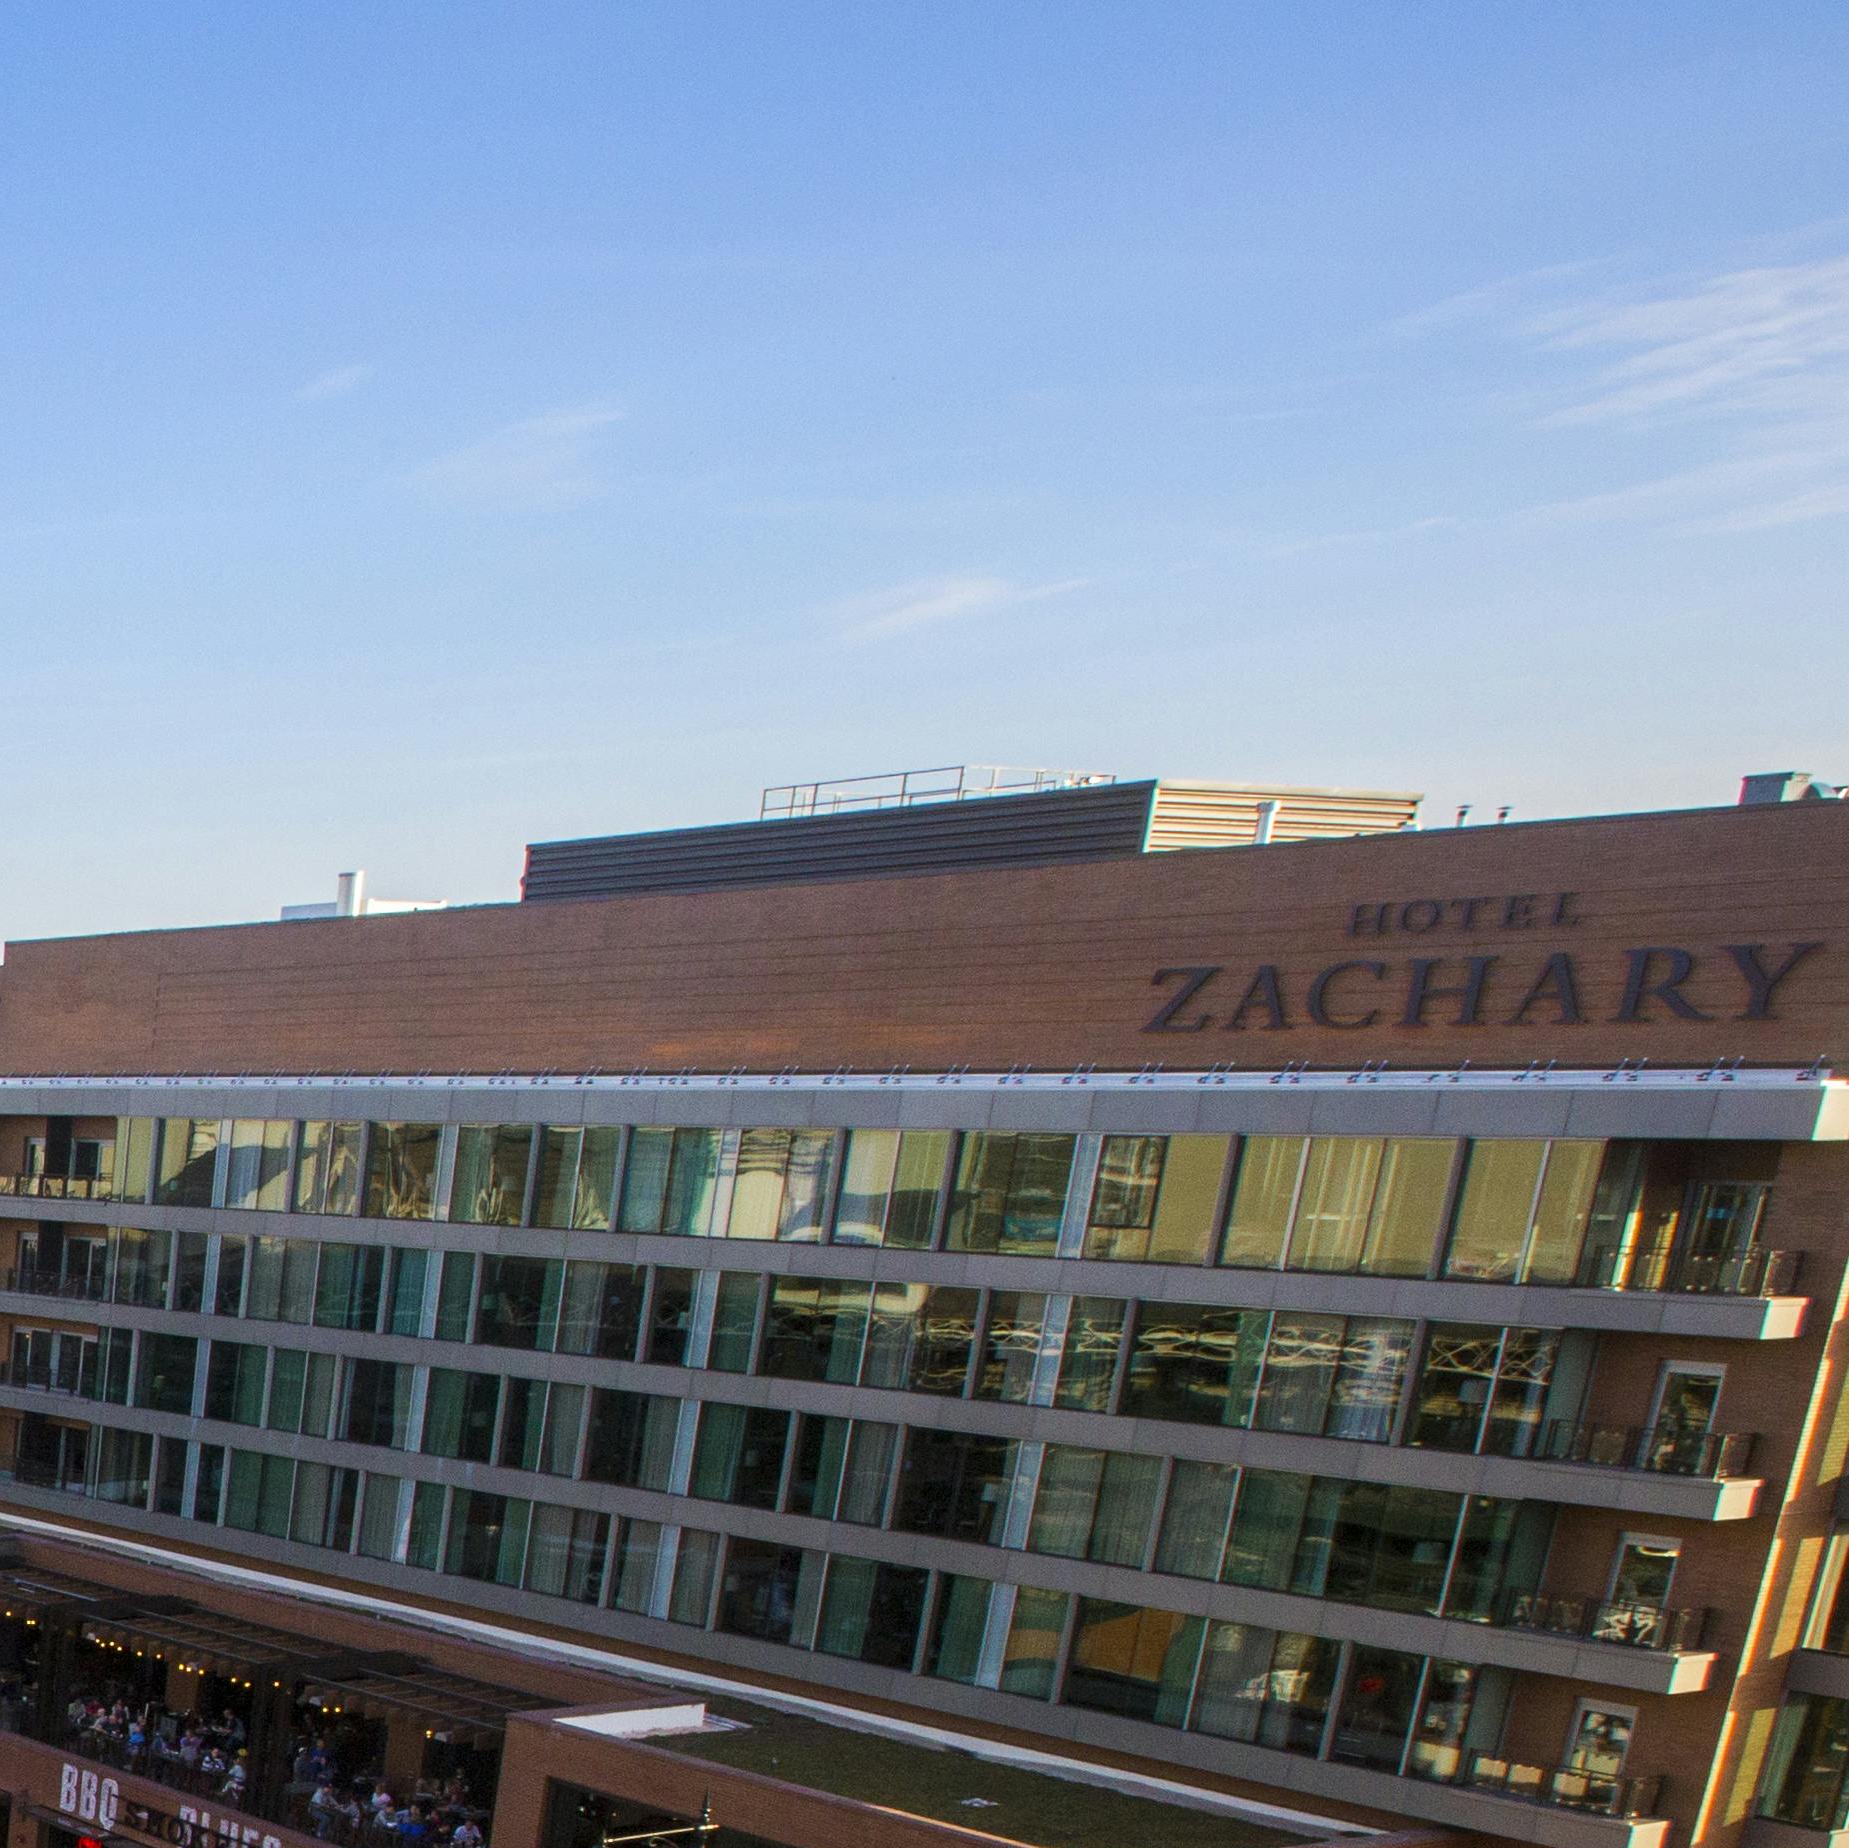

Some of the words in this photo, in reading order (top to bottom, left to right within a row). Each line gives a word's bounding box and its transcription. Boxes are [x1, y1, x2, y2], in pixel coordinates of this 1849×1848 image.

[1346, 891, 1583, 937] HOTEL
[1142, 941, 1824, 1033] ZACHARY
[59, 1763, 119, 1831] BBQ
